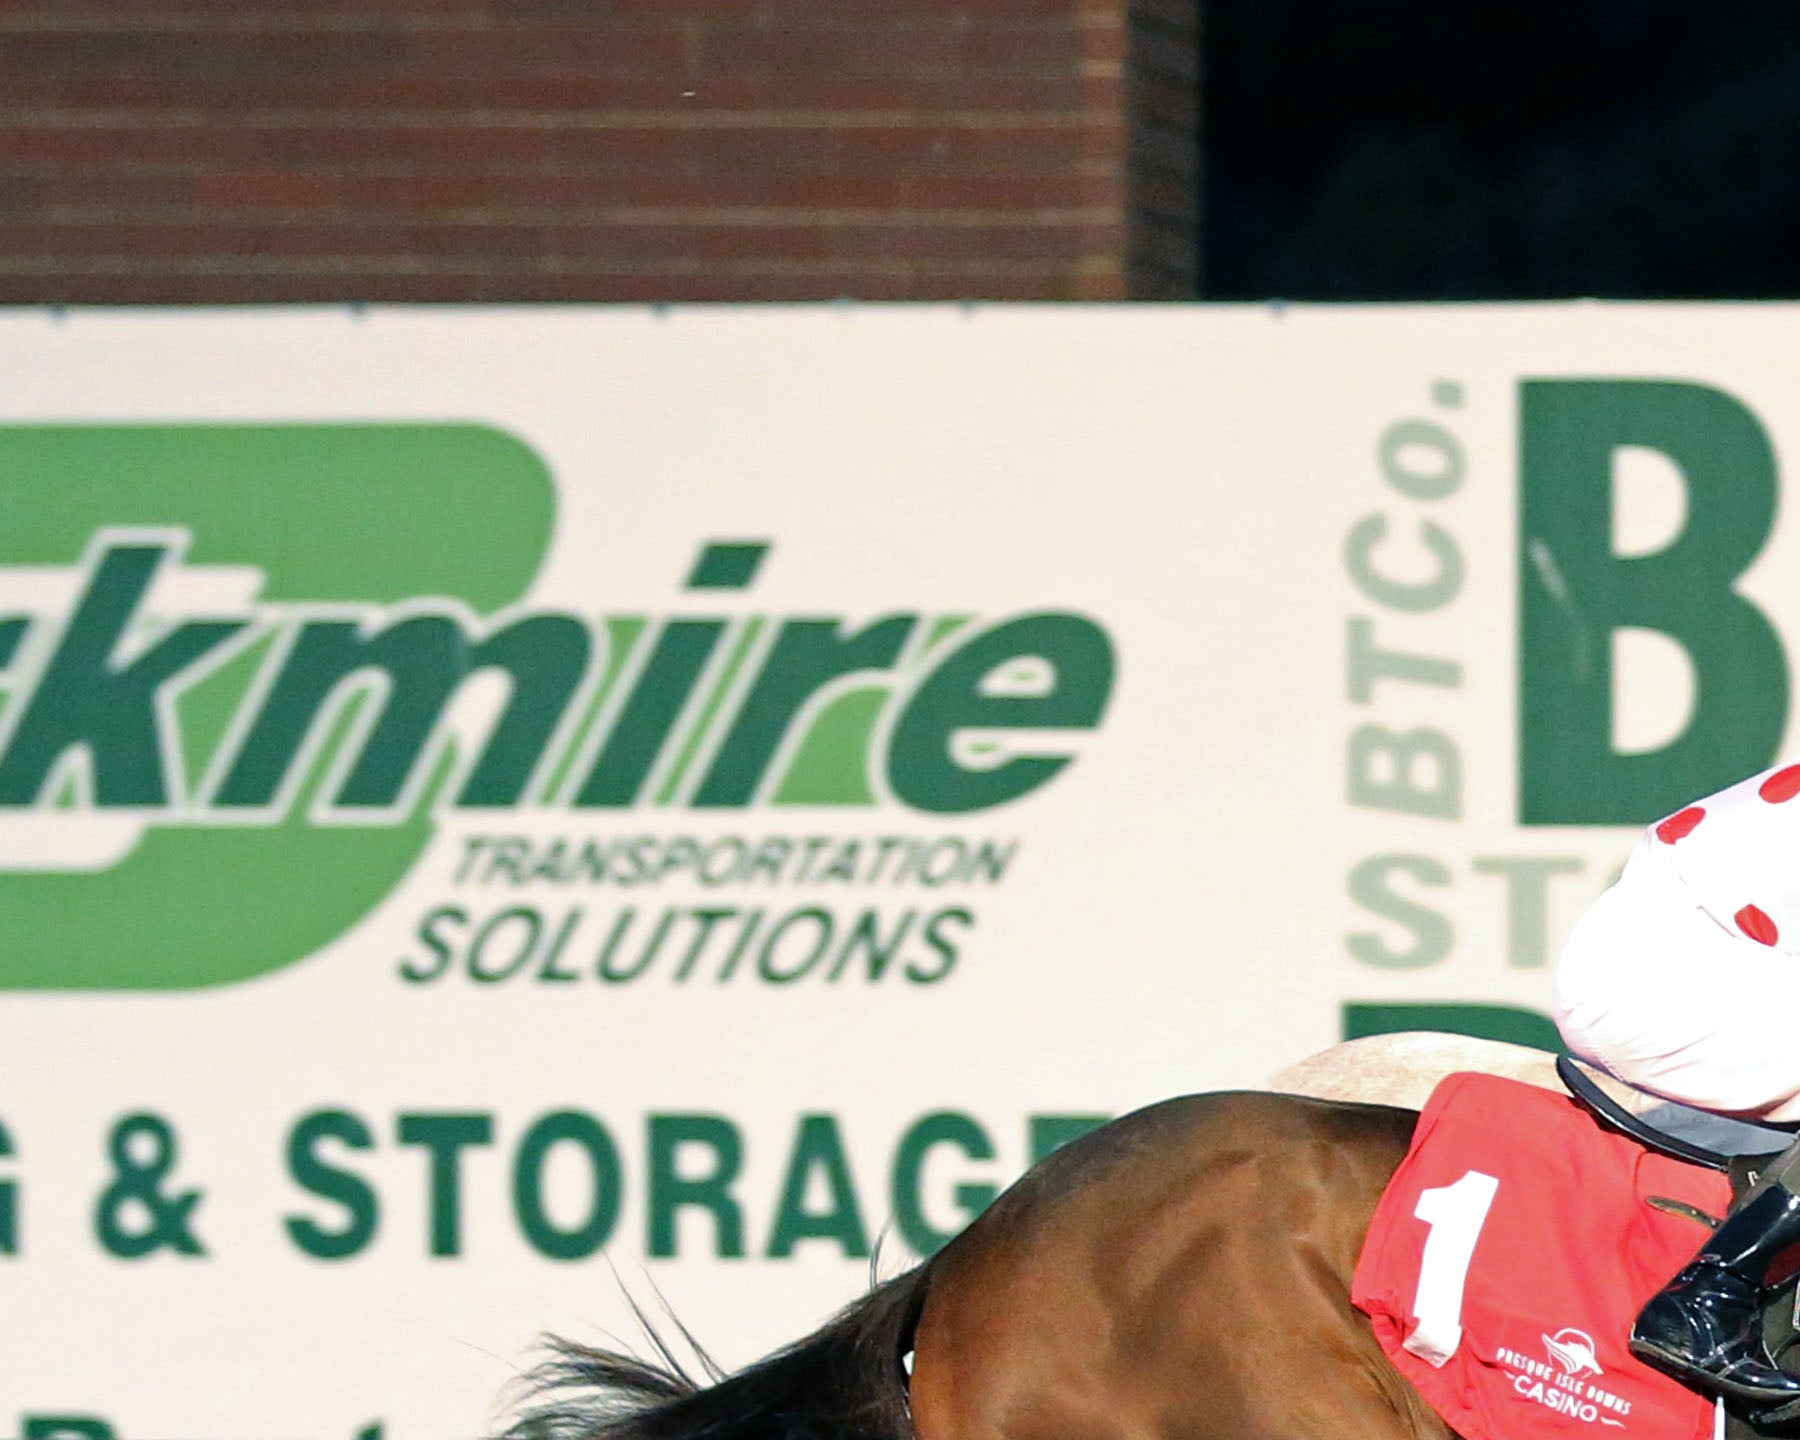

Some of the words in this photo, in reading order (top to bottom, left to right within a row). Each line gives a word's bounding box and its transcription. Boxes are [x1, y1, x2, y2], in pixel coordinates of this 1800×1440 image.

[1344, 378, 1467, 822] BTCo.
[0, 540, 1117, 814] kmire
[453, 836, 1019, 886] TRANSPORTATION
[400, 906, 974, 983] SOLUTIONS
[93, 1110, 208, 1259] &
[1403, 1169, 1499, 1368] 1
[1496, 1347, 1554, 1381] PRESQUE
[1555, 1371, 1585, 1394] ISLE
[1586, 1385, 1632, 1415] DOWNS
[1513, 1375, 1598, 1422] CASINO
